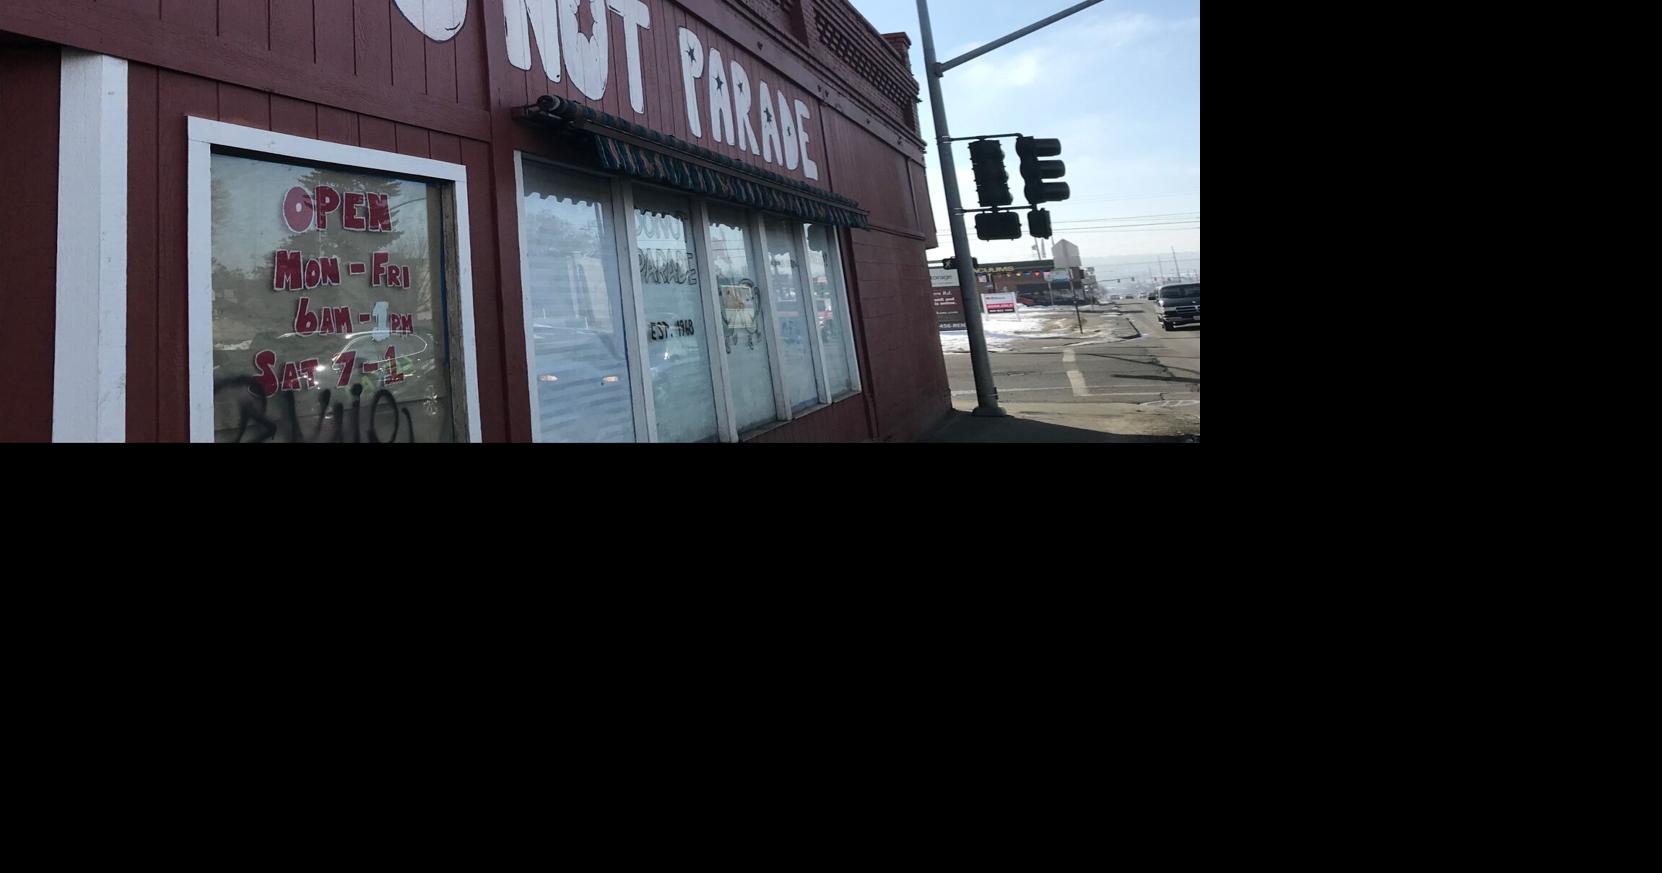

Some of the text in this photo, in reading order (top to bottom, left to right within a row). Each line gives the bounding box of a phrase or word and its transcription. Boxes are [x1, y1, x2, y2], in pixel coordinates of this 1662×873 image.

[679, 26, 818, 181] PARADE
[283, 185, 393, 233] OPEN
[636, 247, 698, 286] PARADE
